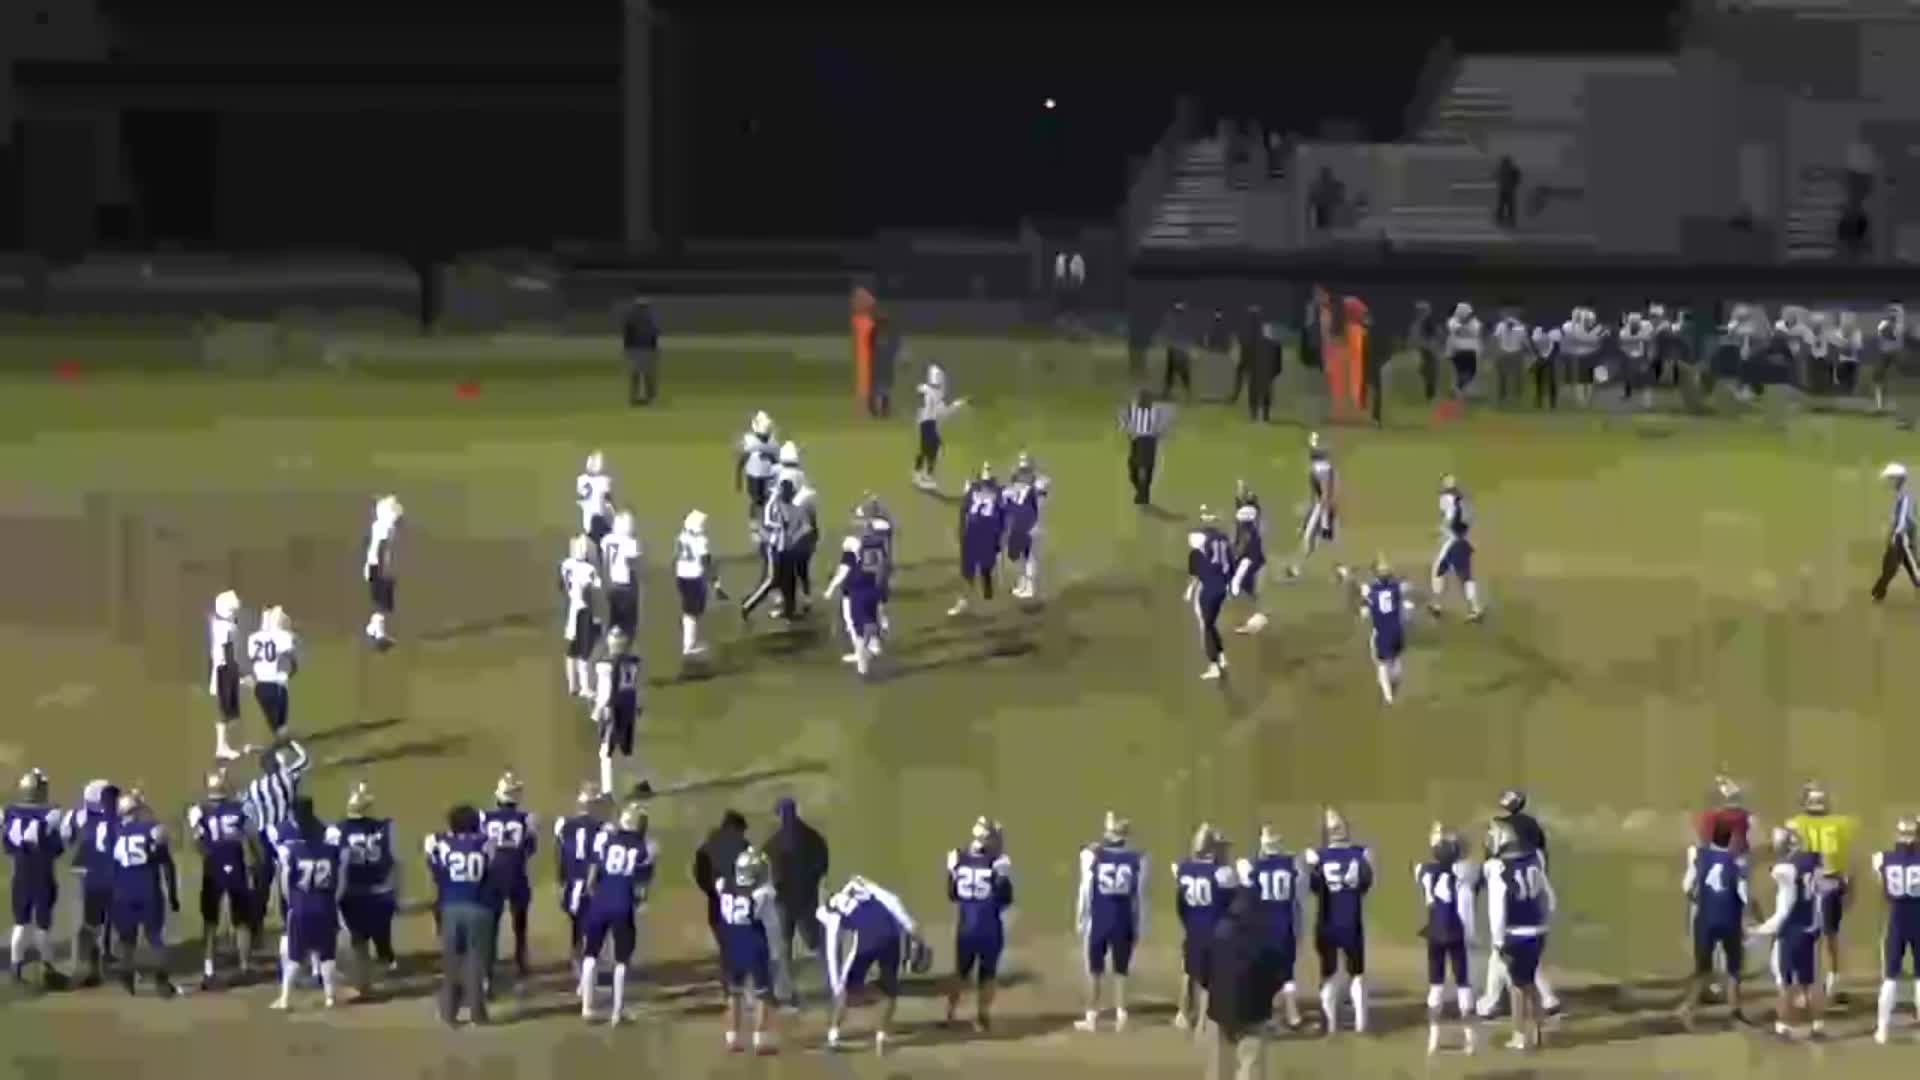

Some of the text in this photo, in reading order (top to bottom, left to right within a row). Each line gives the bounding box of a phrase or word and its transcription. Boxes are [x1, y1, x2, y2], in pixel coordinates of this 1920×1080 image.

[253, 639, 277, 663] 20
[8, 817, 39, 847] 44
[207, 815, 240, 842] 15
[113, 835, 147, 868] 45
[449, 851, 485, 883] 20
[605, 844, 637, 877] 81
[297, 858, 333, 890] 72
[955, 866, 992, 900] 25
[1258, 869, 1291, 901] 10
[1322, 858, 1359, 892] 54
[1420, 871, 1452, 906] 14
[1703, 862, 1726, 893] 4
